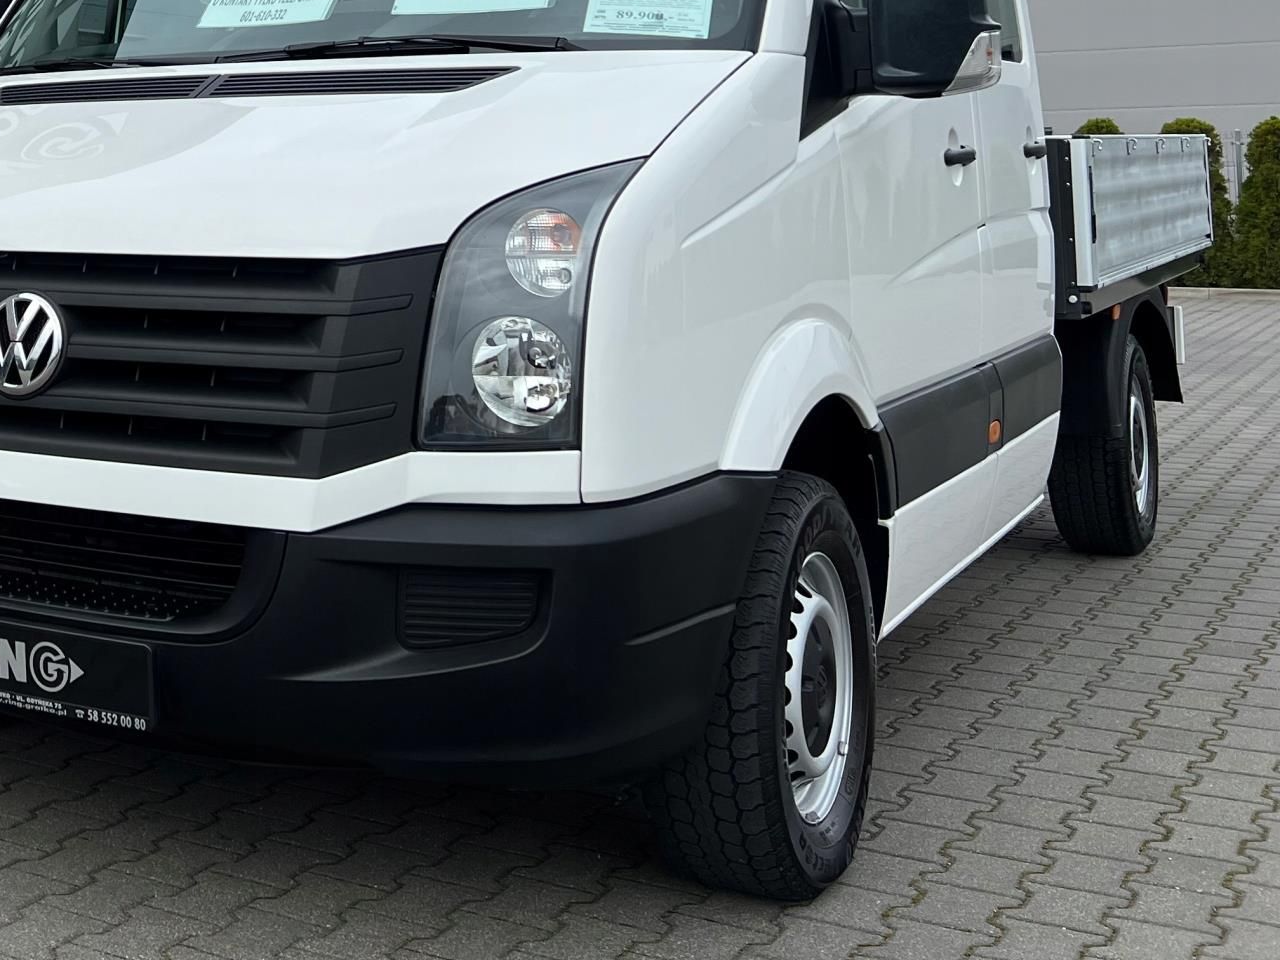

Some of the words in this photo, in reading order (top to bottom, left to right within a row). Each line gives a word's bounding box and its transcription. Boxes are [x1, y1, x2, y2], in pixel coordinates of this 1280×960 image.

[240, 9, 288, 22] 601-610-332
[87, 709, 99, 722] 58
[101, 712, 118, 726] 552
[120, 715, 132, 728] 00
[134, 718, 146, 731] 80
